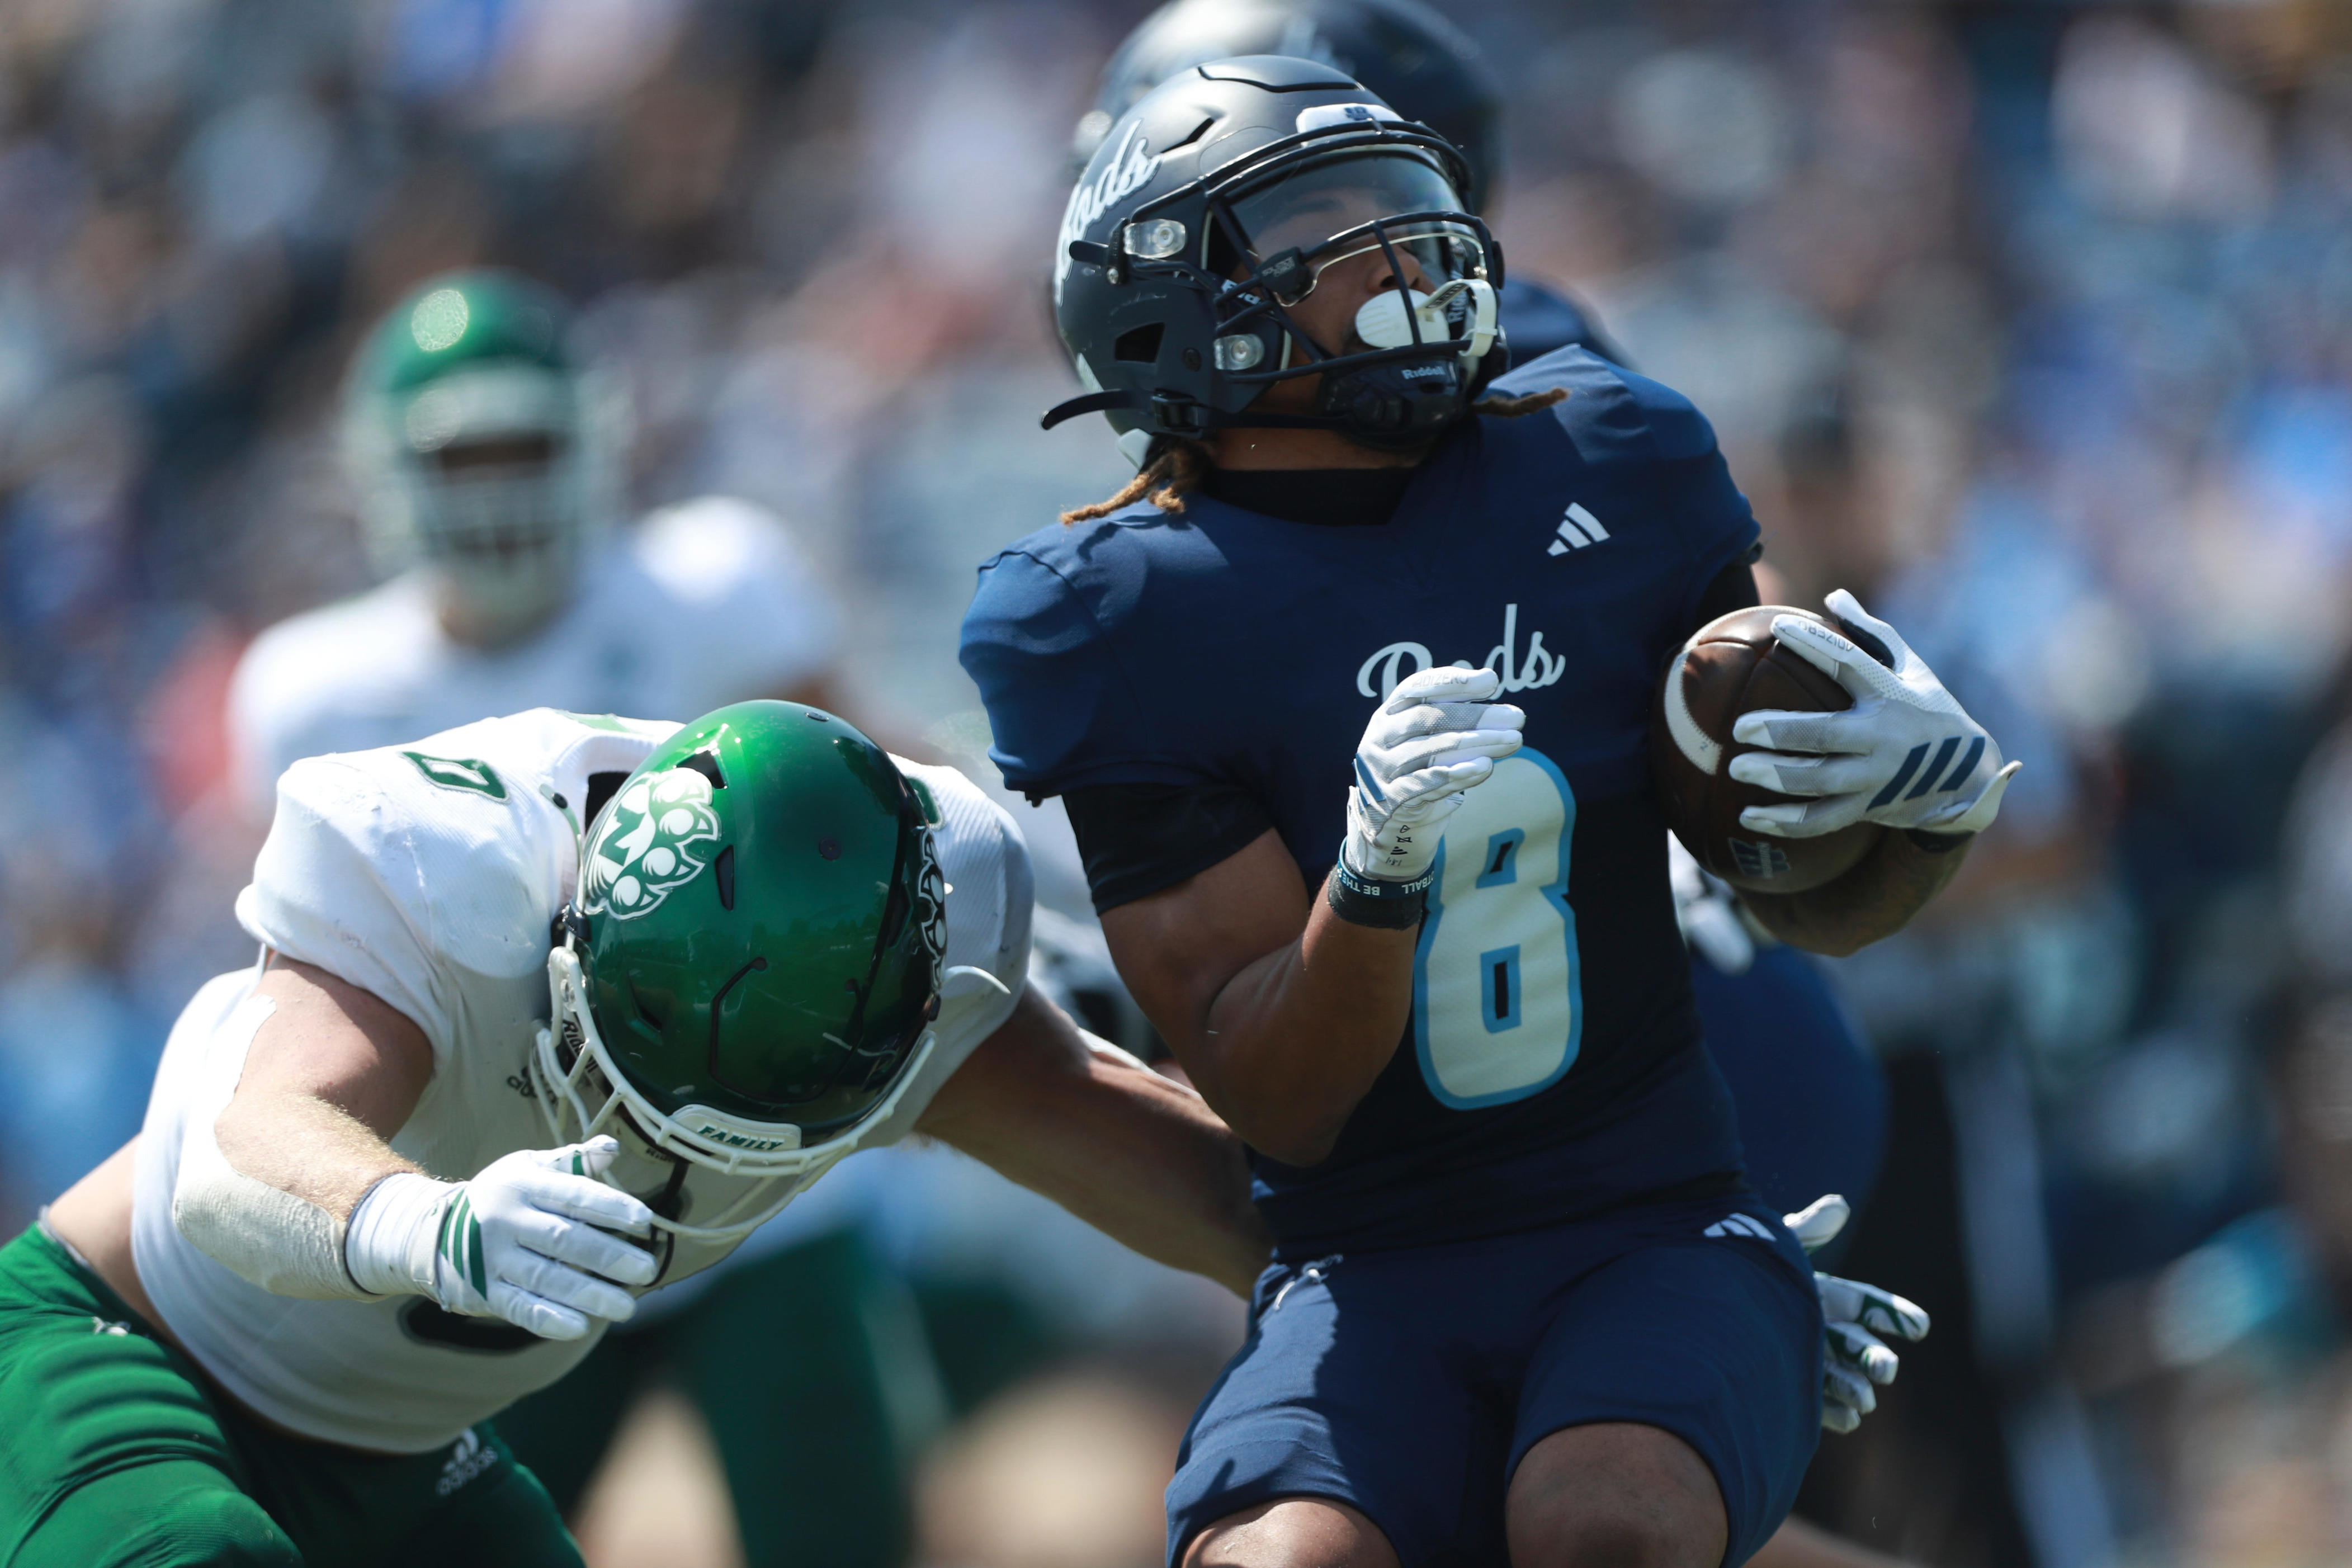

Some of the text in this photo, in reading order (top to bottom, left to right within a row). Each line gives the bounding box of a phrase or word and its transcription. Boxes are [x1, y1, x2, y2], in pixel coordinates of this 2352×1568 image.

[1798, 620, 1856, 652] ADIZERO
[1412, 672, 1470, 688] ADIZERO
[1363, 885, 1381, 896] BE
[1414, 745, 1582, 1110] 8
[698, 1125, 783, 1150] FAMILY
